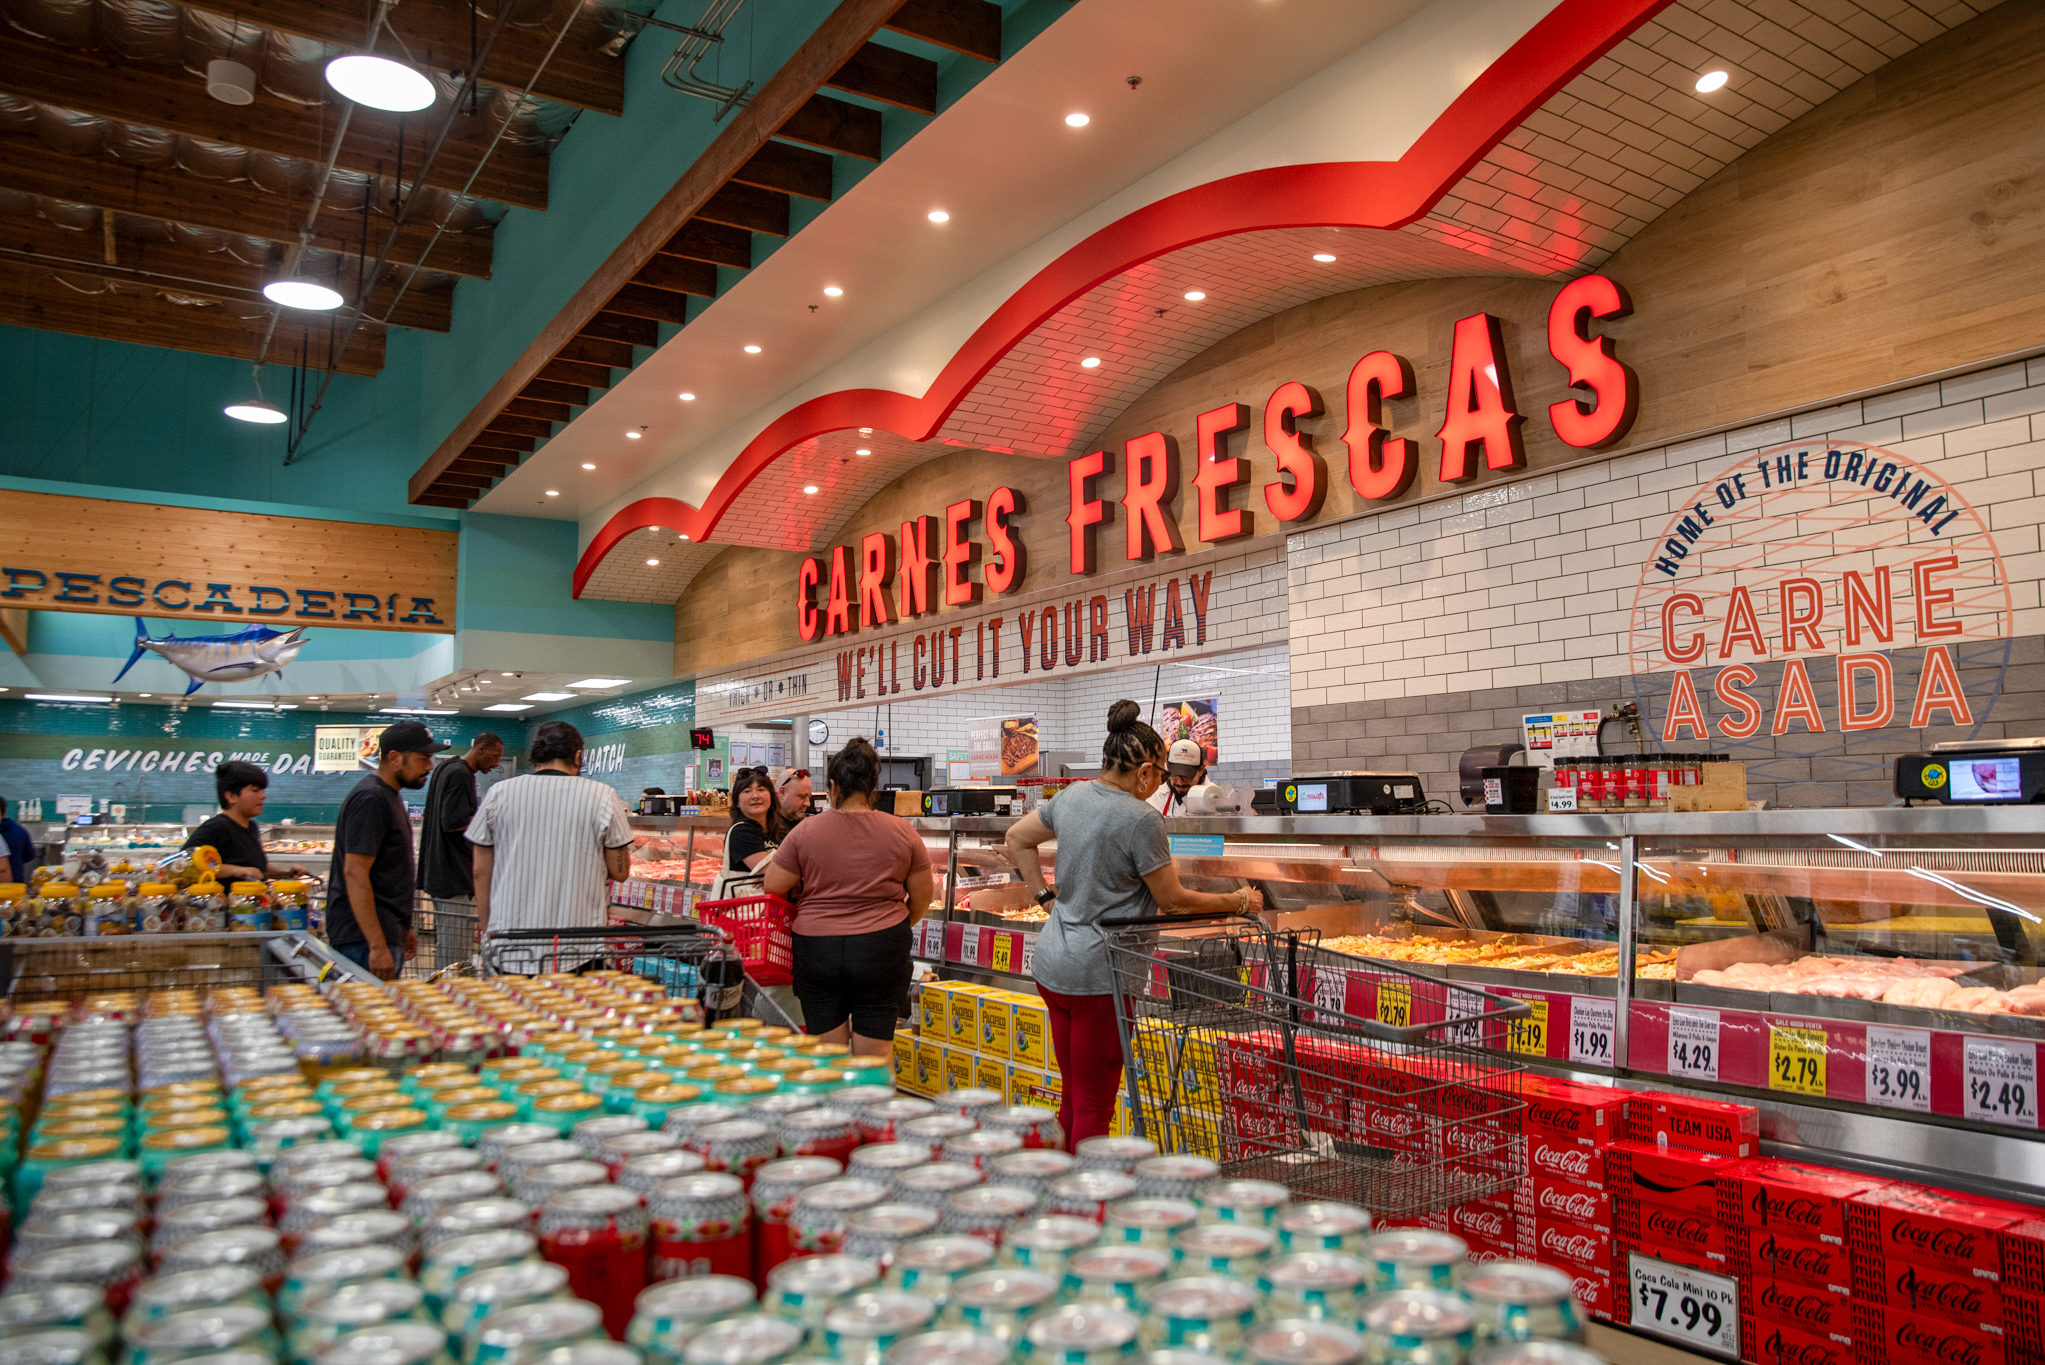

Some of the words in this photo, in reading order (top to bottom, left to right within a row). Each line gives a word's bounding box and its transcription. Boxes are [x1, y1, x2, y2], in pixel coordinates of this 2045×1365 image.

[798, 487, 1026, 641] CARNES
[1067, 274, 1638, 575] FRESCAS
[1655, 501, 1717, 578] HOME
[1717, 474, 1748, 508] OF
[1758, 450, 1809, 488] THE
[1824, 449, 1962, 537] ORIGINAL
[1660, 554, 1963, 664] CARNE
[836, 641, 901, 702] WE'LL
[913, 626, 963, 691] CUT
[977, 616, 1004, 679] IT
[1019, 595, 1110, 673] YOUR
[1125, 571, 1213, 656] WAY
[763, 680, 773, 702] OR
[788, 673, 807, 697] THIN
[1661, 644, 1974, 742] ASADA
[319, 737, 356, 750] QUALITY
[694, 733, 710, 745] 74
[970, 730, 989, 740] PERFECT
[990, 728, 999, 738] FOR
[973, 742, 983, 751] THE
[61, 748, 224, 773] CEVICHES
[228, 752, 271, 762] MADE
[319, 752, 356, 760] GUARANTEED
[588, 743, 626, 776] CATCH
[948, 752, 969, 761] SAFET
[1551, 801, 1572, 809] $4.99
[922, 997, 944, 1013] PACIFICO
[951, 1003, 974, 1019] PACIFICO
[982, 1010, 1006, 1027] PACIFICO
[1015, 1017, 1041, 1036] PACIFICO
[1574, 1029, 1608, 1058] $1.99
[1673, 1040, 1711, 1072] $4.29
[1775, 1052, 1818, 1086] $2.79
[1872, 1064, 1920, 1100] $3.99
[1630, 1099, 1652, 1110] mini
[1971, 1077, 2025, 1116] $2.49
[1528, 1102, 1583, 1131] Coca-Cola
[1630, 1121, 1652, 1132] mini
[1669, 1117, 1702, 1138] TEAM
[1706, 1119, 1733, 1144] USA
[1534, 1144, 1591, 1175] Coca-Cola
[1609, 1159, 1632, 1173] mini
[1716, 1177, 1742, 1190] mini
[1540, 1187, 1598, 1218] Coca-Cola
[1617, 1197, 1640, 1209] mini
[1752, 1192, 1825, 1225] Cca-Cola
[1454, 1205, 1504, 1235] Coca-Cola
[1516, 1215, 1536, 1226] mini
[1648, 1210, 1712, 1244] Coca-Cola
[1724, 1224, 1750, 1237] mini
[1517, 1242, 1537, 1255] mini
[1542, 1227, 1598, 1260] Coca-Cola
[1891, 1218, 1980, 1259] Coca-Cola
[1759, 1239, 1833, 1275] Cca-Cola
[1635, 1268, 1657, 1284] Coca
[1660, 1275, 1680, 1290] Cola
[1683, 1281, 1703, 1297] Mini
[1706, 1288, 1718, 1301] 10
[1721, 1291, 1733, 1305] Pk
[1856, 1277, 1887, 1293] mini
[1896, 1270, 1985, 1313] Cca-Cola
[1639, 1282, 1722, 1337] $7.99
